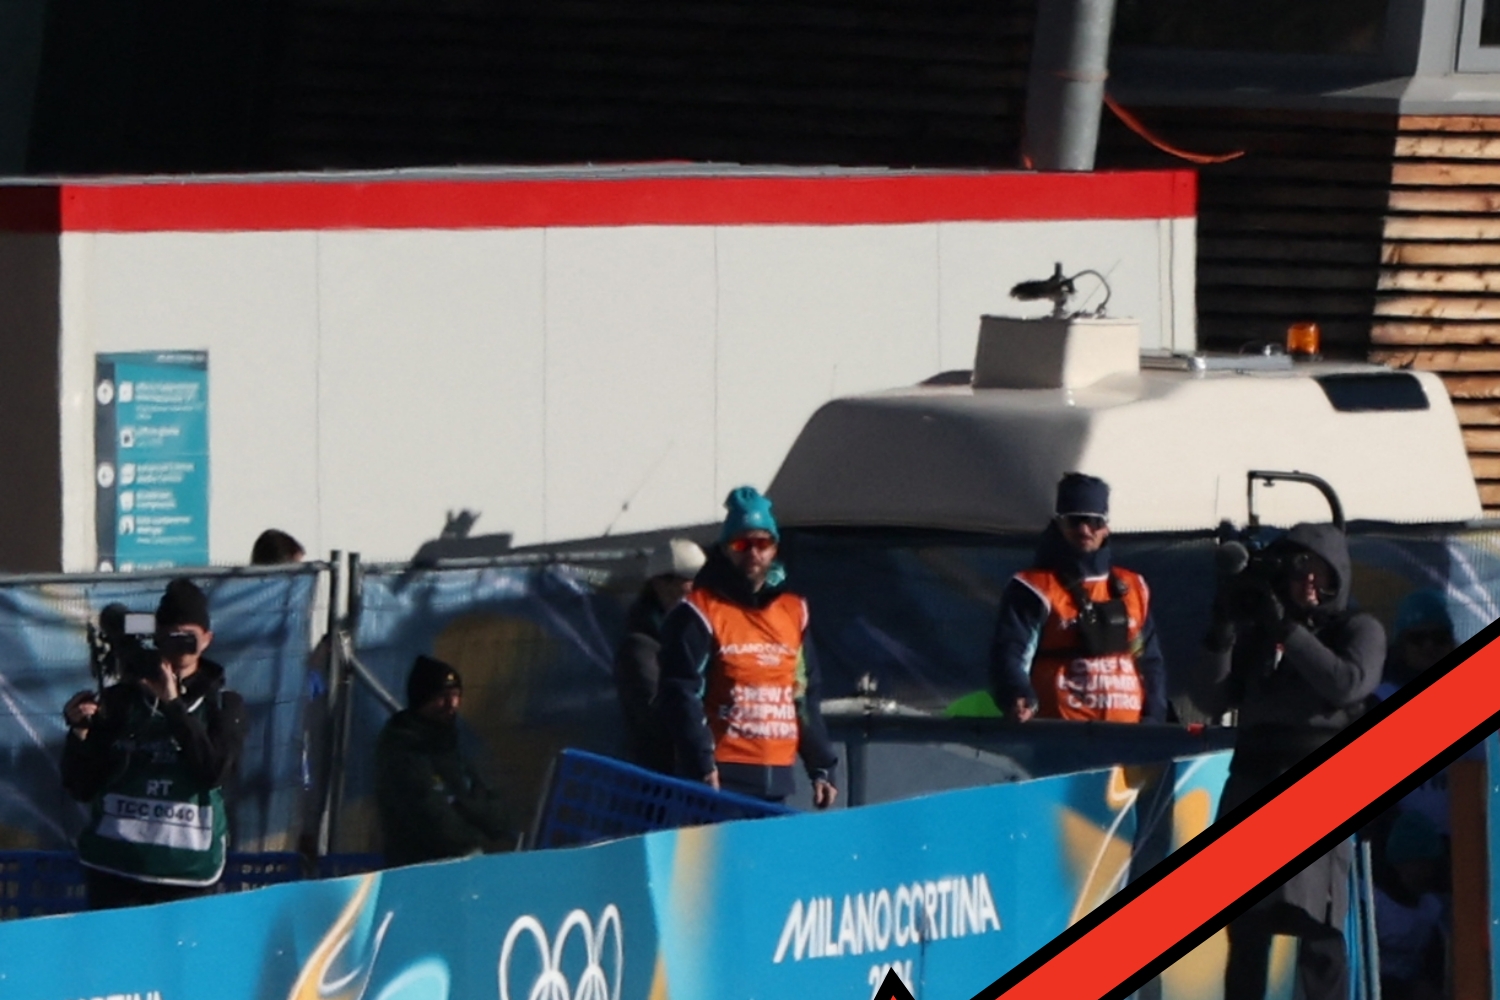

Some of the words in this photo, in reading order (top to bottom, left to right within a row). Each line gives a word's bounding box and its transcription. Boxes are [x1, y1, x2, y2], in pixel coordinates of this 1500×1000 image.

[146, 779, 174, 797] RT
[773, 888, 892, 964] MILANO
[895, 872, 1001, 948] CORTINA
